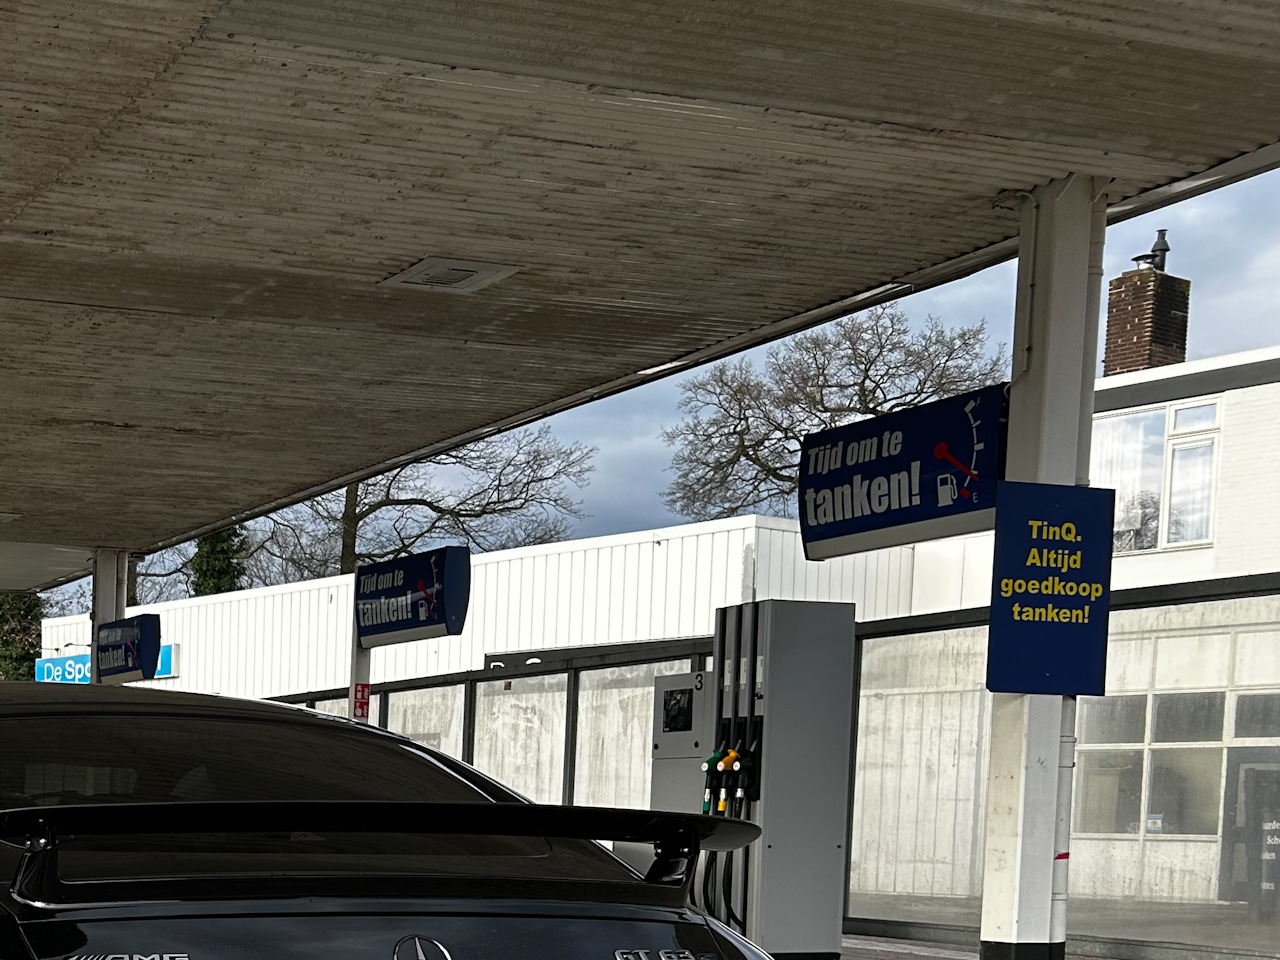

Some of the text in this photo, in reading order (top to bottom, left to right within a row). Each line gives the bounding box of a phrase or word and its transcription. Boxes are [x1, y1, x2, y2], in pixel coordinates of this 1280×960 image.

[807, 430, 903, 475] Tijd om te
[804, 460, 921, 527] tanken!
[1028, 520, 1082, 543] TinQ.
[1025, 548, 1082, 573] Altijd
[359, 569, 404, 595] Tijd om te
[1000, 576, 1103, 602] goedkoop
[357, 590, 413, 627] tanken!
[1012, 602, 1090, 624] tanken!
[44, 660, 91, 683] De Spo
[694, 673, 703, 691] 3
